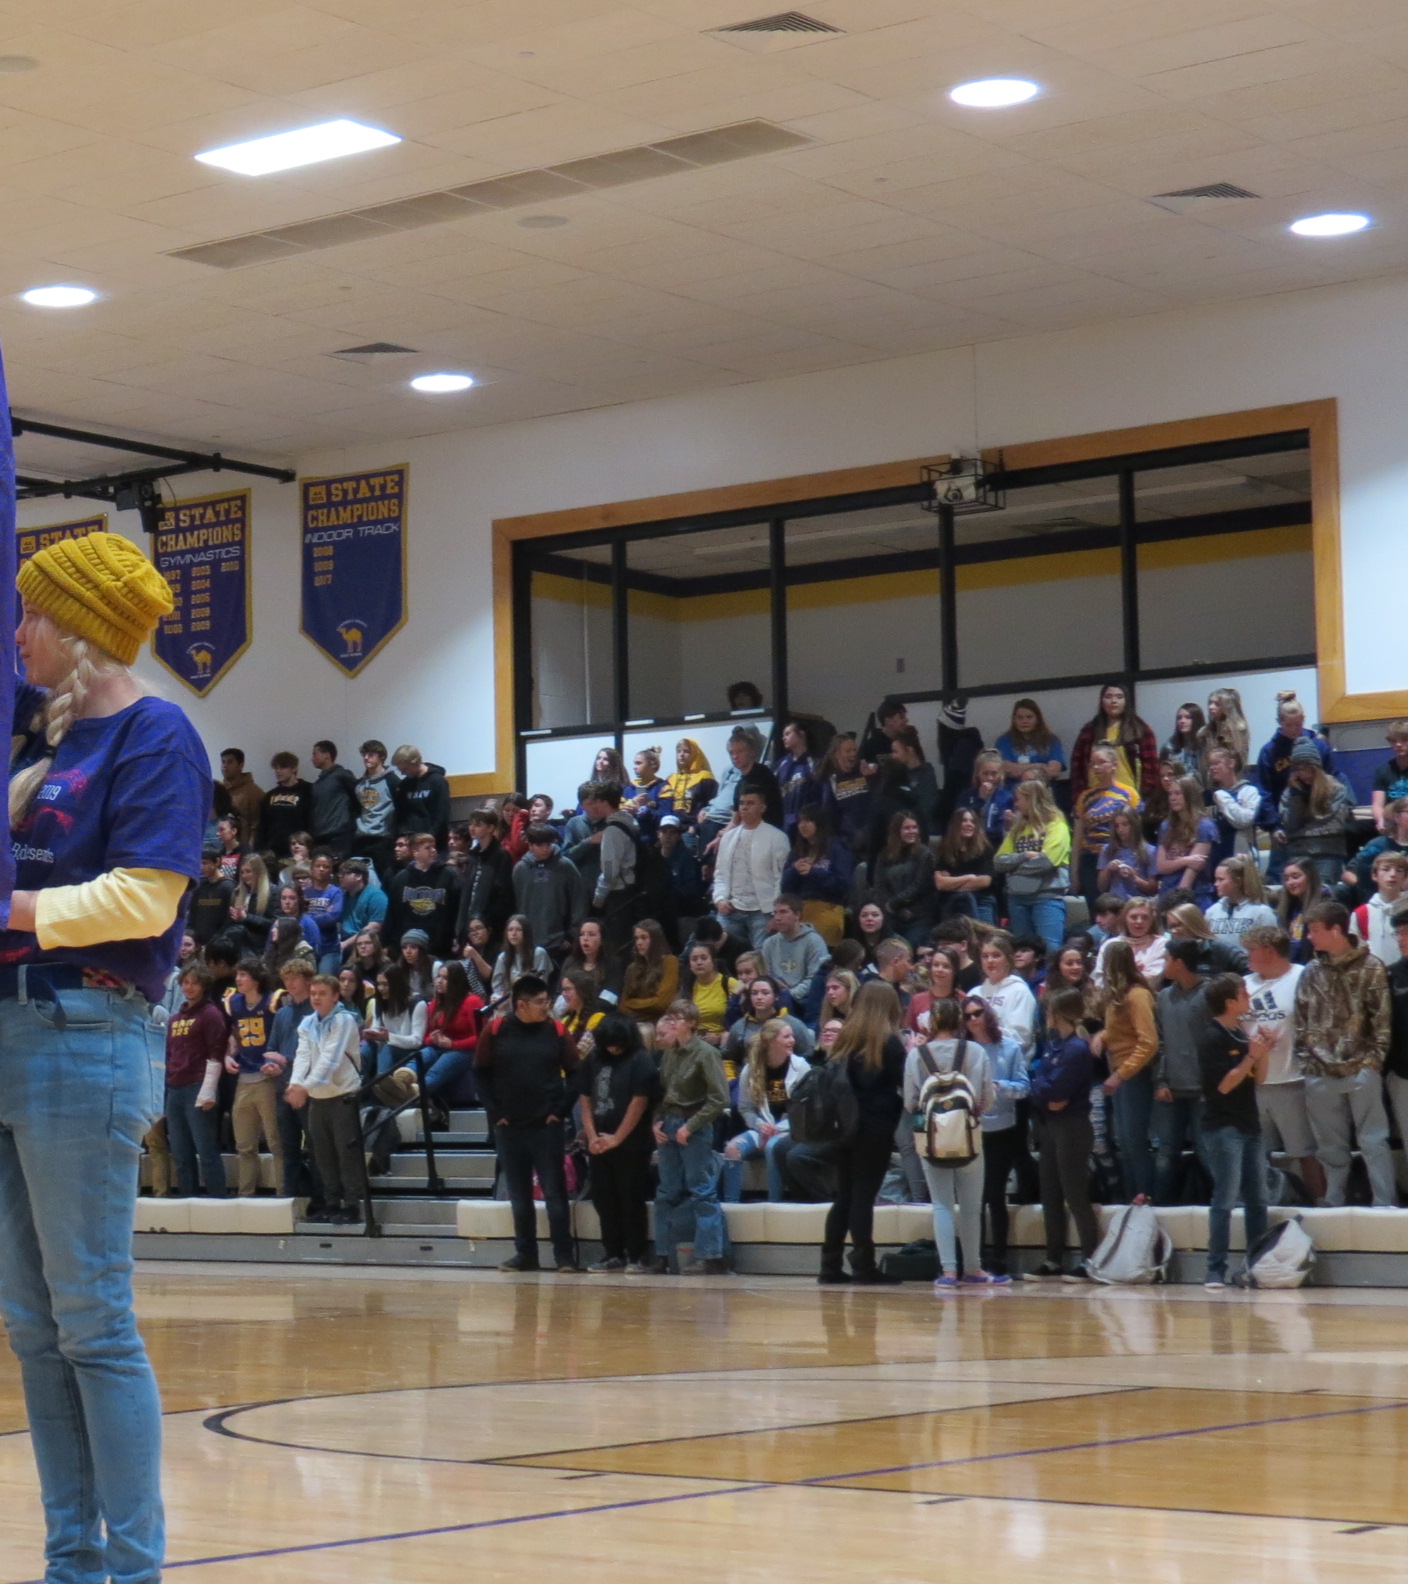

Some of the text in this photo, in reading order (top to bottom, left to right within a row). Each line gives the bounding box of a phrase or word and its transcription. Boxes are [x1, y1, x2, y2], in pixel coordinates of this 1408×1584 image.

[331, 475, 399, 502] STATE
[180, 501, 242, 528] STATE
[308, 499, 400, 528] CHAMPIONS
[158, 524, 242, 553] CHAMPIONS
[305, 523, 400, 544] INDOOR TRACK
[160, 547, 241, 568] GYMNASTICS
[238, 1018, 266, 1048] 29
